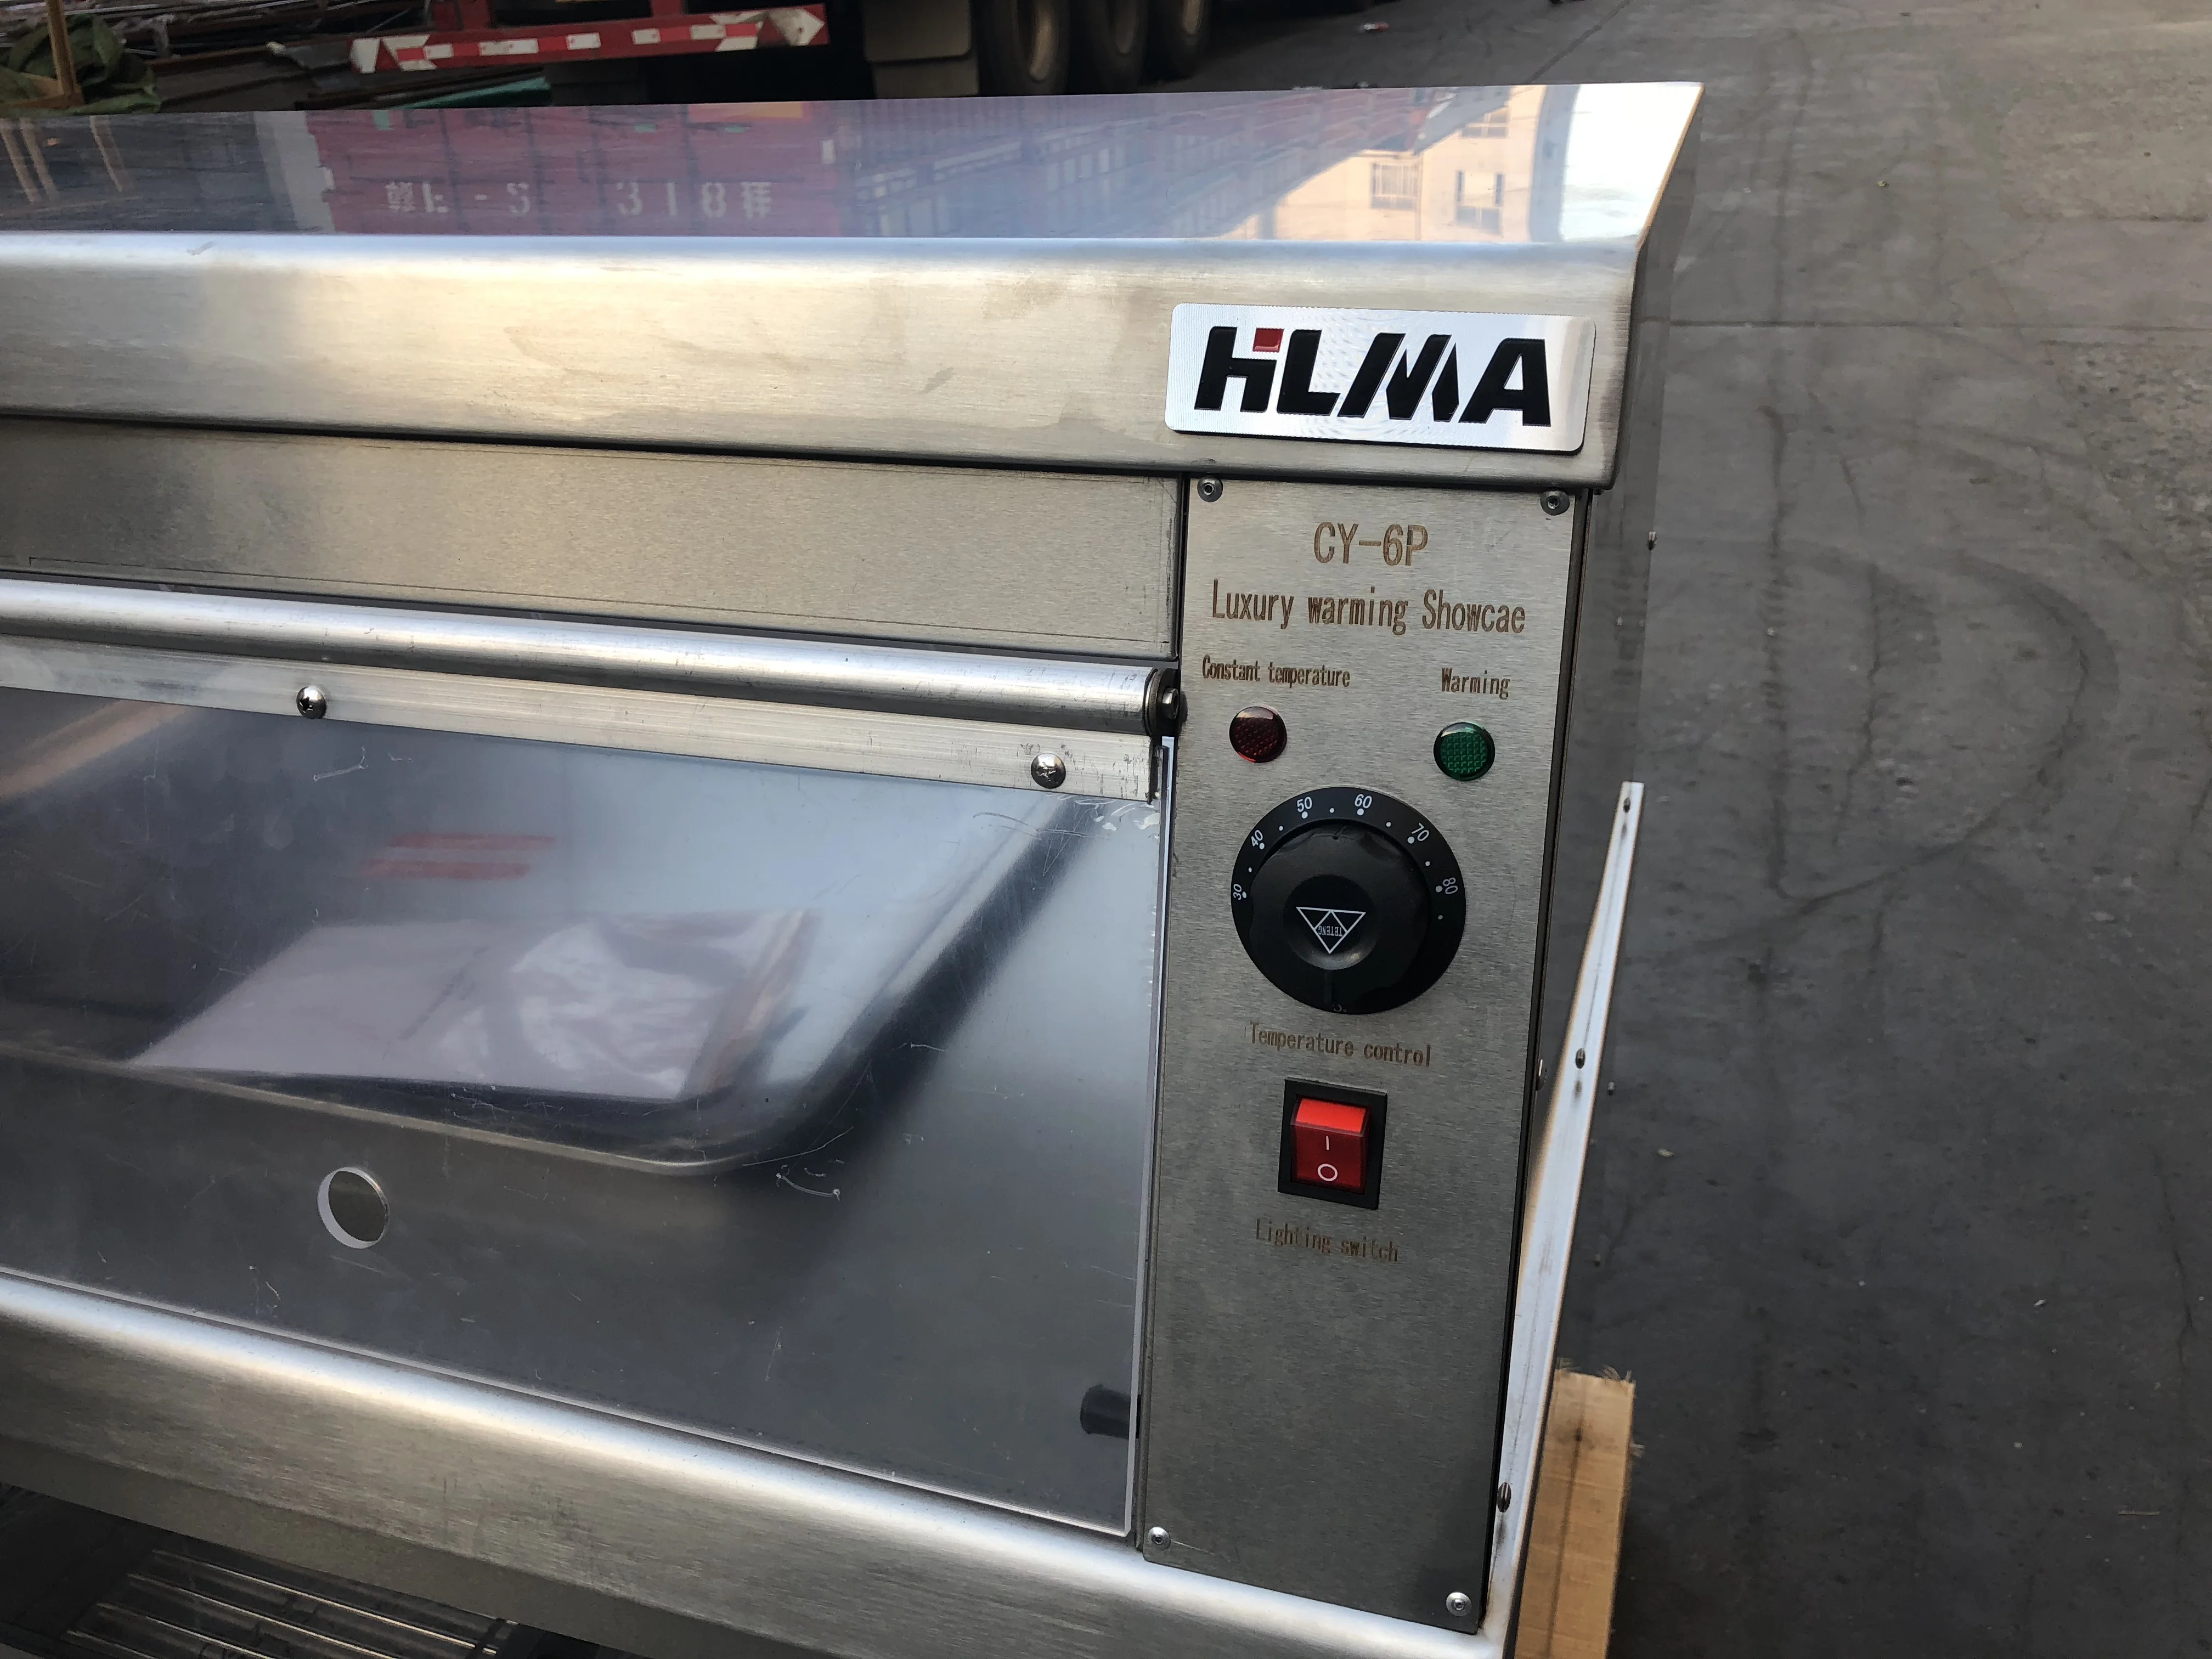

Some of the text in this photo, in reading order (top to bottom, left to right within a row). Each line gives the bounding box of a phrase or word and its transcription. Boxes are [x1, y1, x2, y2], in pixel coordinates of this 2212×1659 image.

[1313, 521, 1428, 566] CY-6P
[1212, 578, 1525, 636] Luxury warming Showcae
[1202, 653, 1351, 689] Constant temperature
[1441, 667, 1510, 700] Warming
[1233, 793, 1459, 900] 30 40 50 60 70 80
[1250, 1019, 1431, 1068] Temperature control
[1256, 1218, 1398, 1262] Lighting switch
